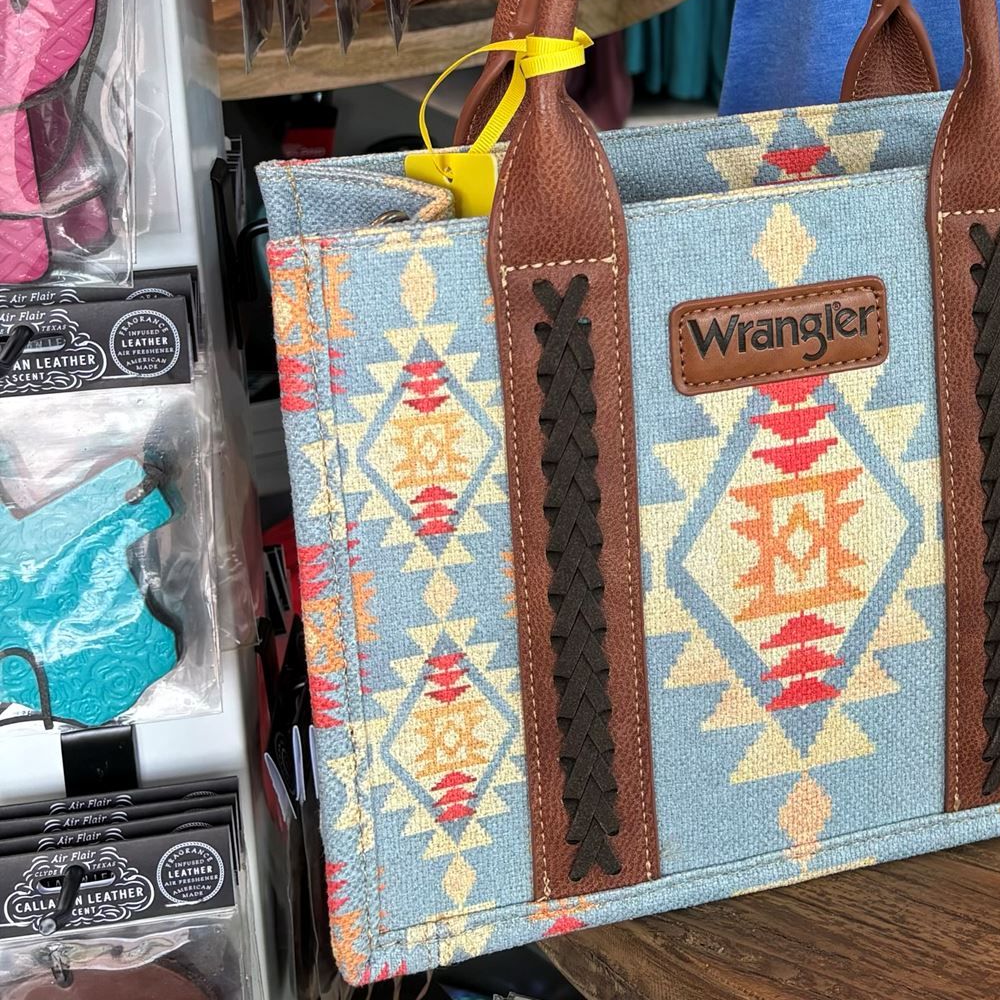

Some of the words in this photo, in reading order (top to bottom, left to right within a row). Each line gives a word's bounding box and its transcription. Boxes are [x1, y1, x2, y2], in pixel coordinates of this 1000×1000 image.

[10, 293, 27, 304] Air
[30, 291, 56, 302] Flair
[0, 312, 16, 322] Air
[18, 310, 46, 322] Flair
[41, 324, 67, 332] TEXAS
[687, 302, 875, 361] Wrangler
[122, 337, 168, 348] LEATHER
[132, 347, 174, 355] FRESHENER
[36, 354, 96, 369] LEATHER
[126, 357, 167, 366] AMERICAN
[12, 372, 45, 382] SCENT
[68, 800, 84, 810] Air
[87, 798, 112, 808] Flair
[63, 817, 80, 827] Air
[82, 814, 107, 825] Flair
[57, 835, 74, 845] Air
[76, 832, 101, 843] Flair
[51, 854, 68, 864] Air
[70, 850, 96, 862] Flair
[34, 869, 58, 877] CLYDE
[92, 861, 116, 870] TEXAS
[174, 859, 204, 868] INFUSED
[168, 865, 213, 878] LEATHER
[179, 875, 218, 885] FRESHENER
[173, 885, 212, 895] AMERICAN
[15, 895, 83, 913] CALLAN
[87, 886, 143, 904] LEATHER
[70, 906, 96, 916] CENT
